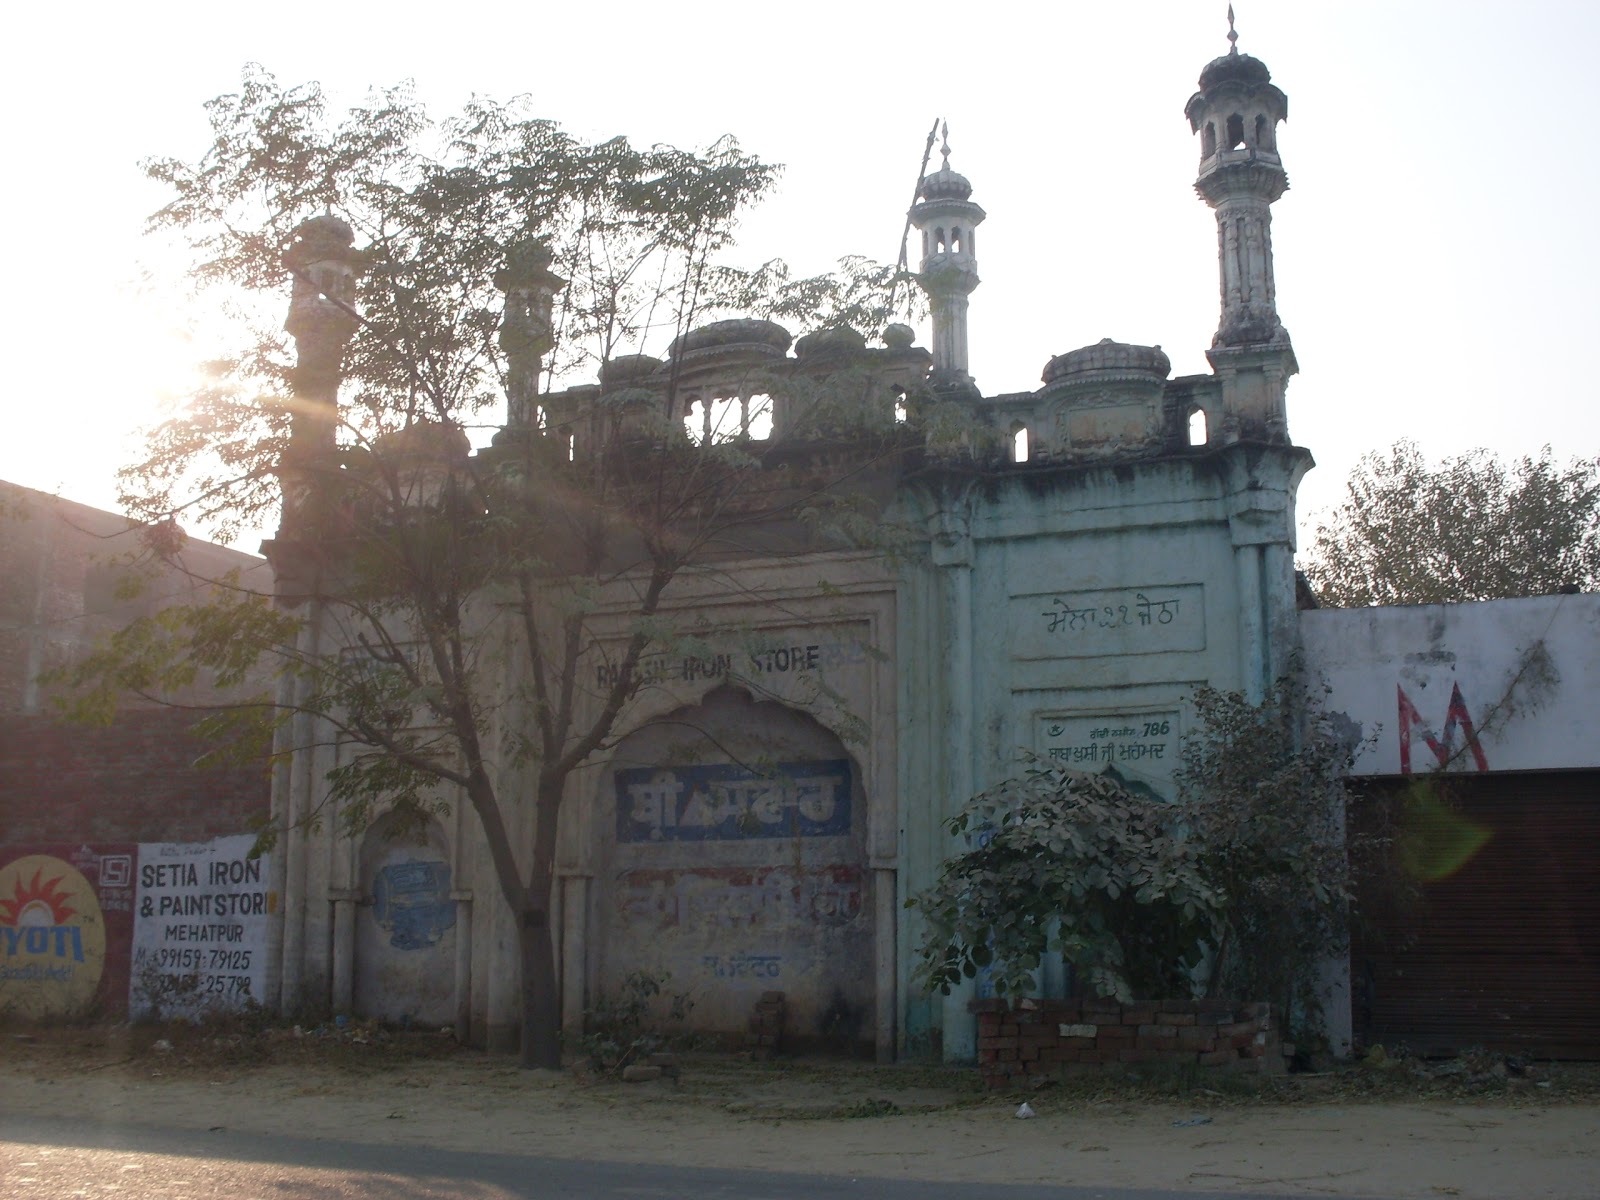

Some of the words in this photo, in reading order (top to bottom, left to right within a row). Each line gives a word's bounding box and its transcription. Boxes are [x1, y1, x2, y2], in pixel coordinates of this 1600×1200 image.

[682, 653, 731, 681] IRON
[1143, 720, 1170, 738] 786
[141, 864, 198, 888] SETIA
[209, 861, 261, 885] IRON
[141, 895, 153, 918] &
[0, 926, 85, 962] YOTI
[165, 924, 244, 942] MEHATPUR
